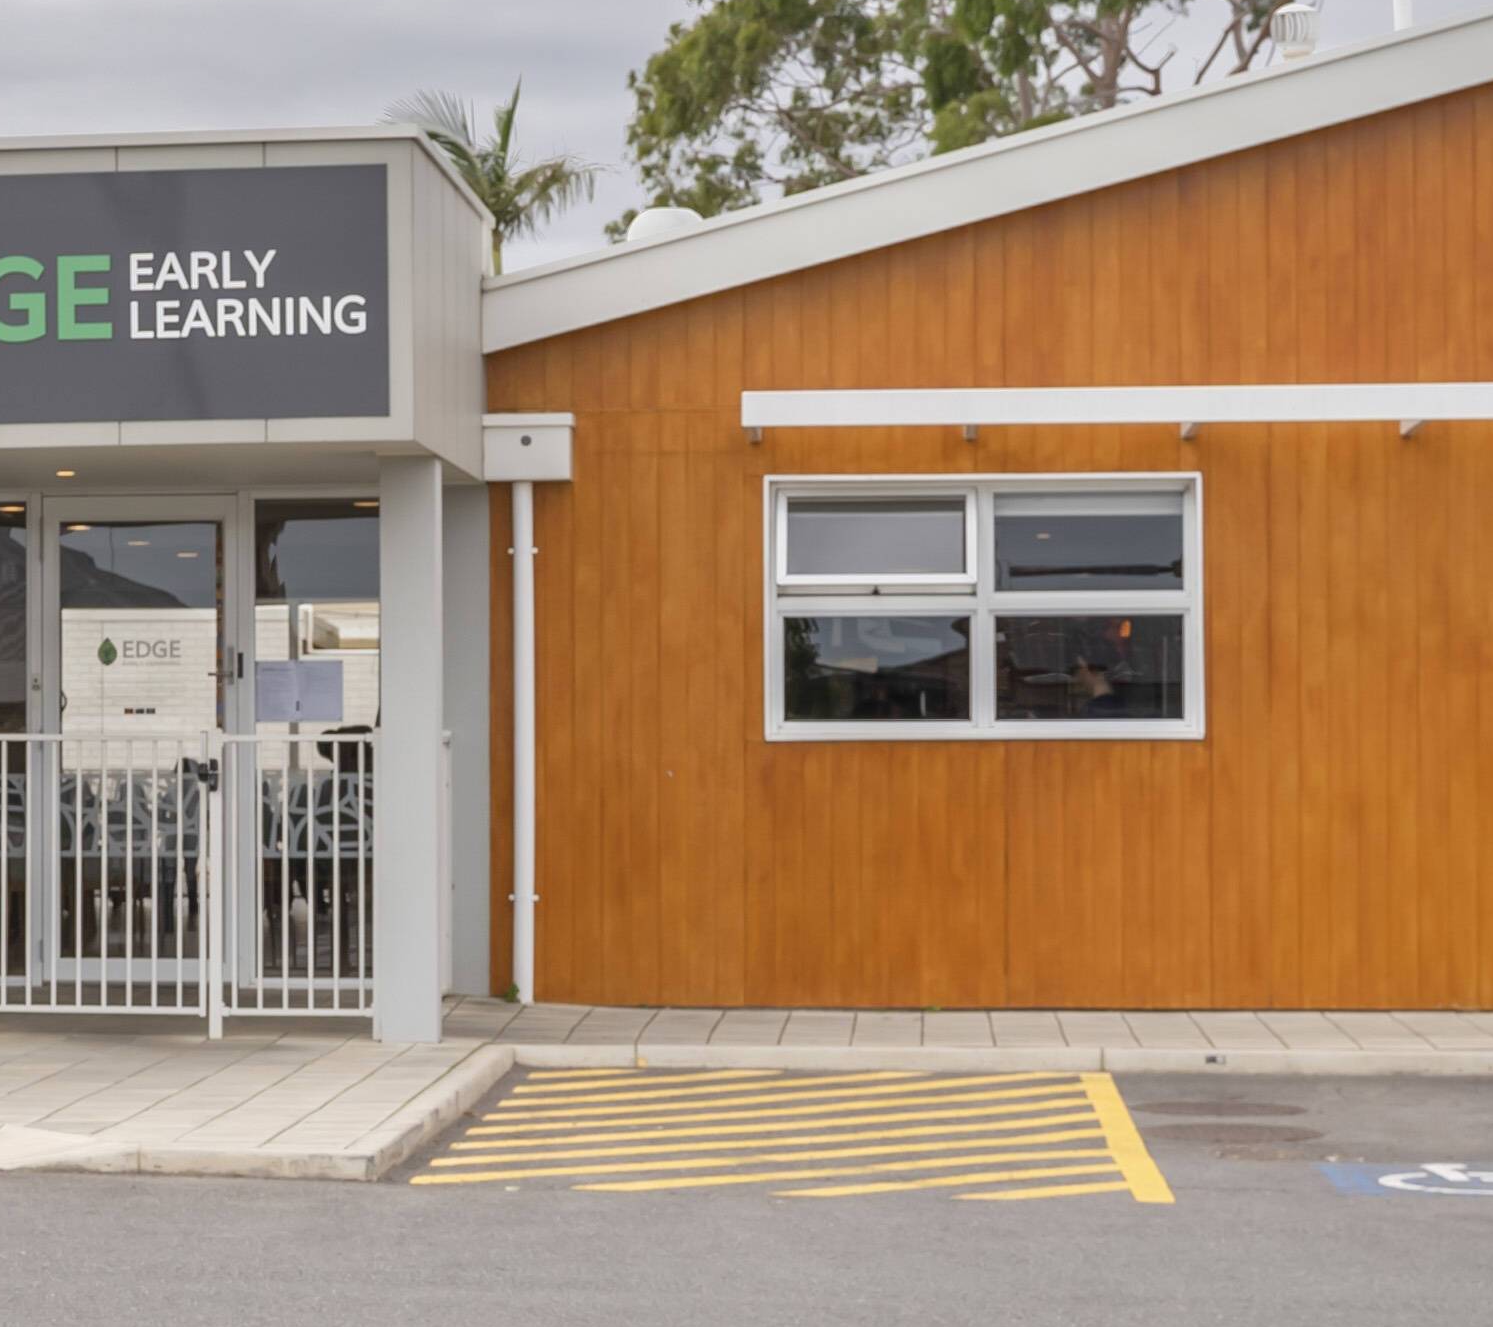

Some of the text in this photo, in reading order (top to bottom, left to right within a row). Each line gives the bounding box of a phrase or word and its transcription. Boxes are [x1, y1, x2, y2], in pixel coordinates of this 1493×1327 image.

[129, 249, 277, 291] EARLY
[129, 295, 367, 339] LEARNING
[123, 640, 181, 658] EDGE
